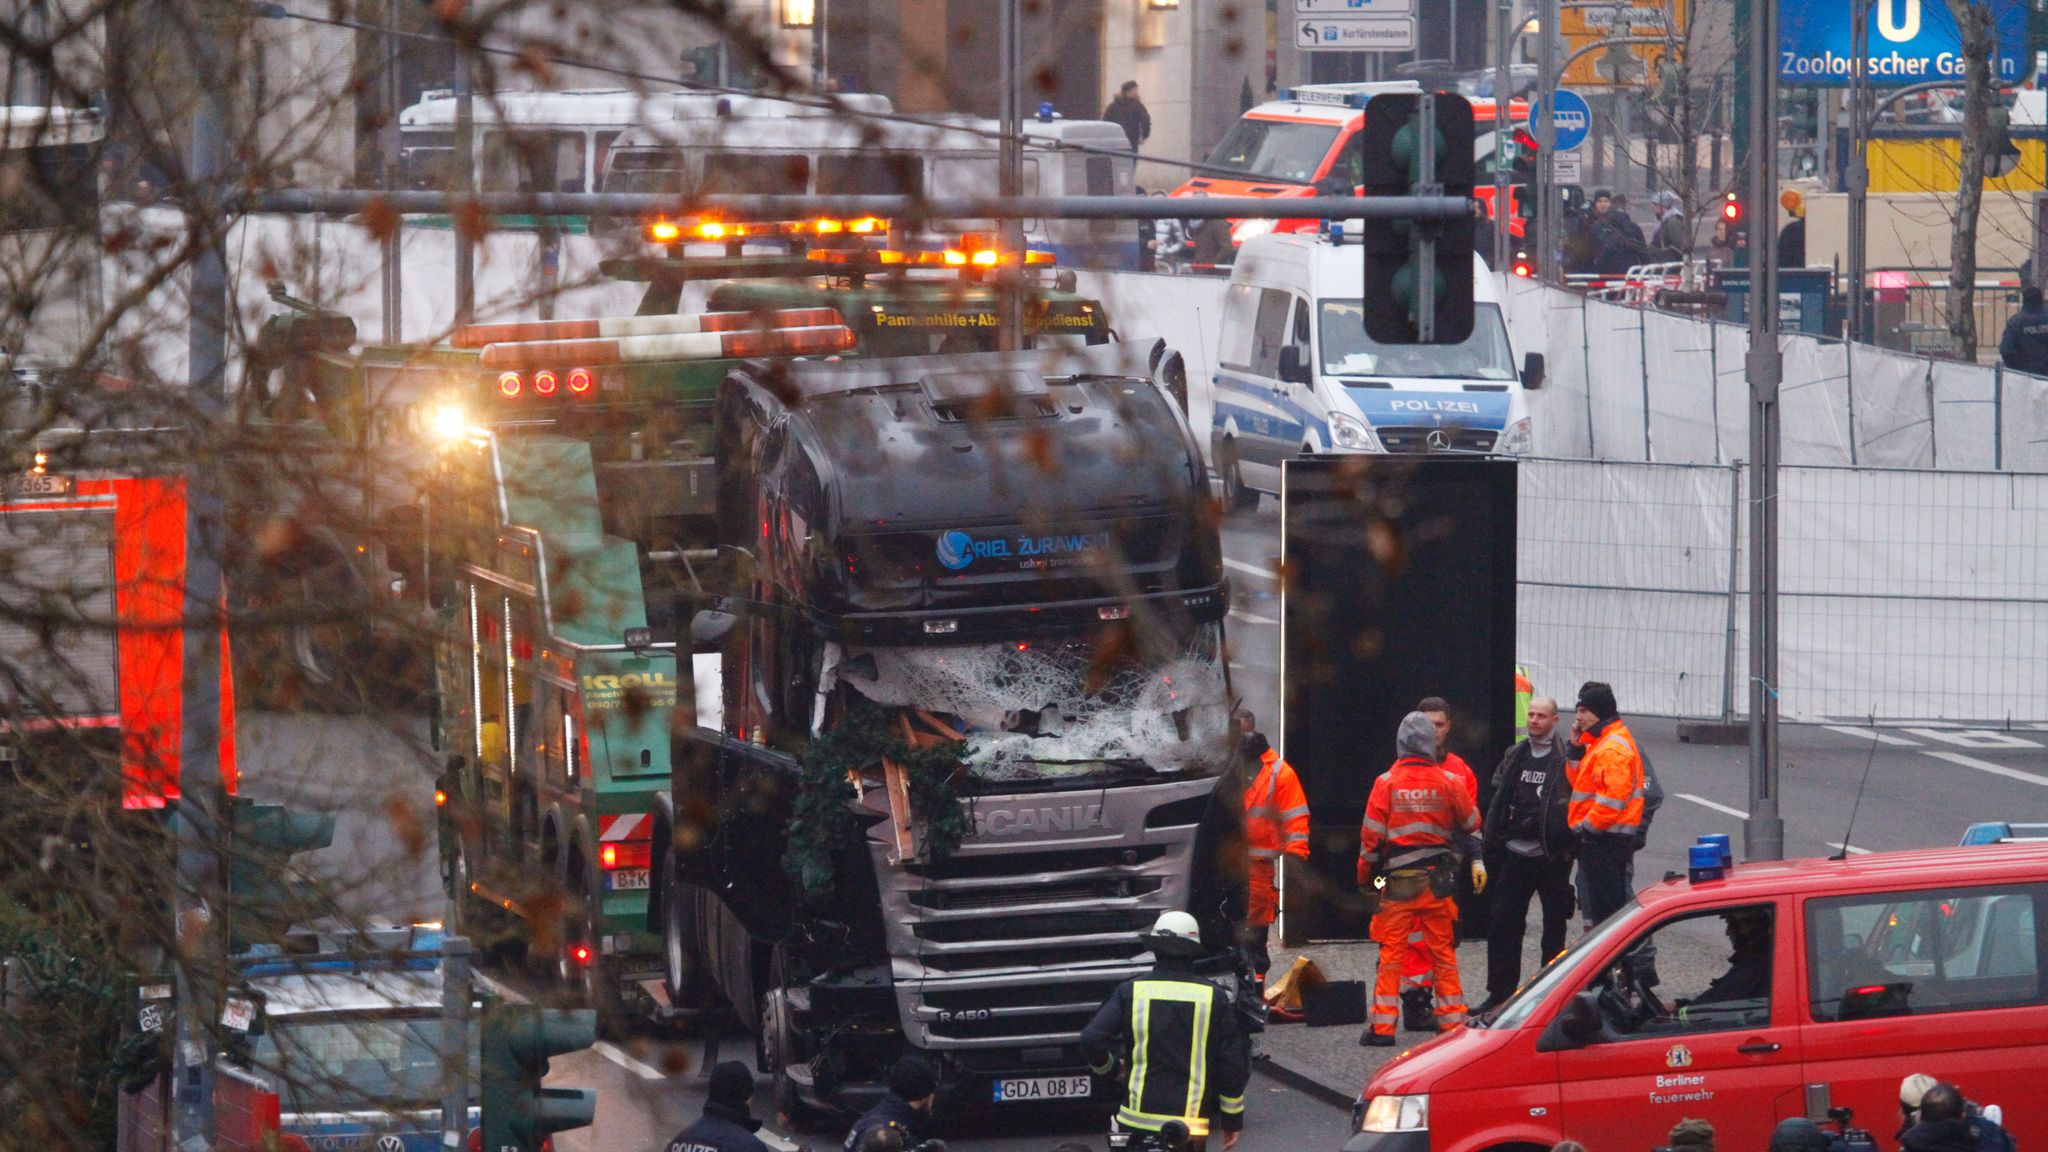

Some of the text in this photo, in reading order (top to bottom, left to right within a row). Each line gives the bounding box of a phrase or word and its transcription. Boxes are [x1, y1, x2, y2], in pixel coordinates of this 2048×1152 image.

[1878, 0, 1921, 42] U
[1342, 28, 1408, 39] Kurfürstendamm
[1782, 51, 2015, 79] Zoologscher Gan
[1298, 91, 1344, 103] FEUERWEHR
[1390, 399, 1479, 414] POLIZEI
[962, 540, 1012, 559] ARIEL
[964, 805, 1112, 836] SCANIA
[939, 1010, 989, 1022] R 450
[1655, 1074, 1705, 1088] Berliner
[1004, 1081, 1041, 1098] GDA
[1649, 1088, 1714, 1104] Feuerwehr
